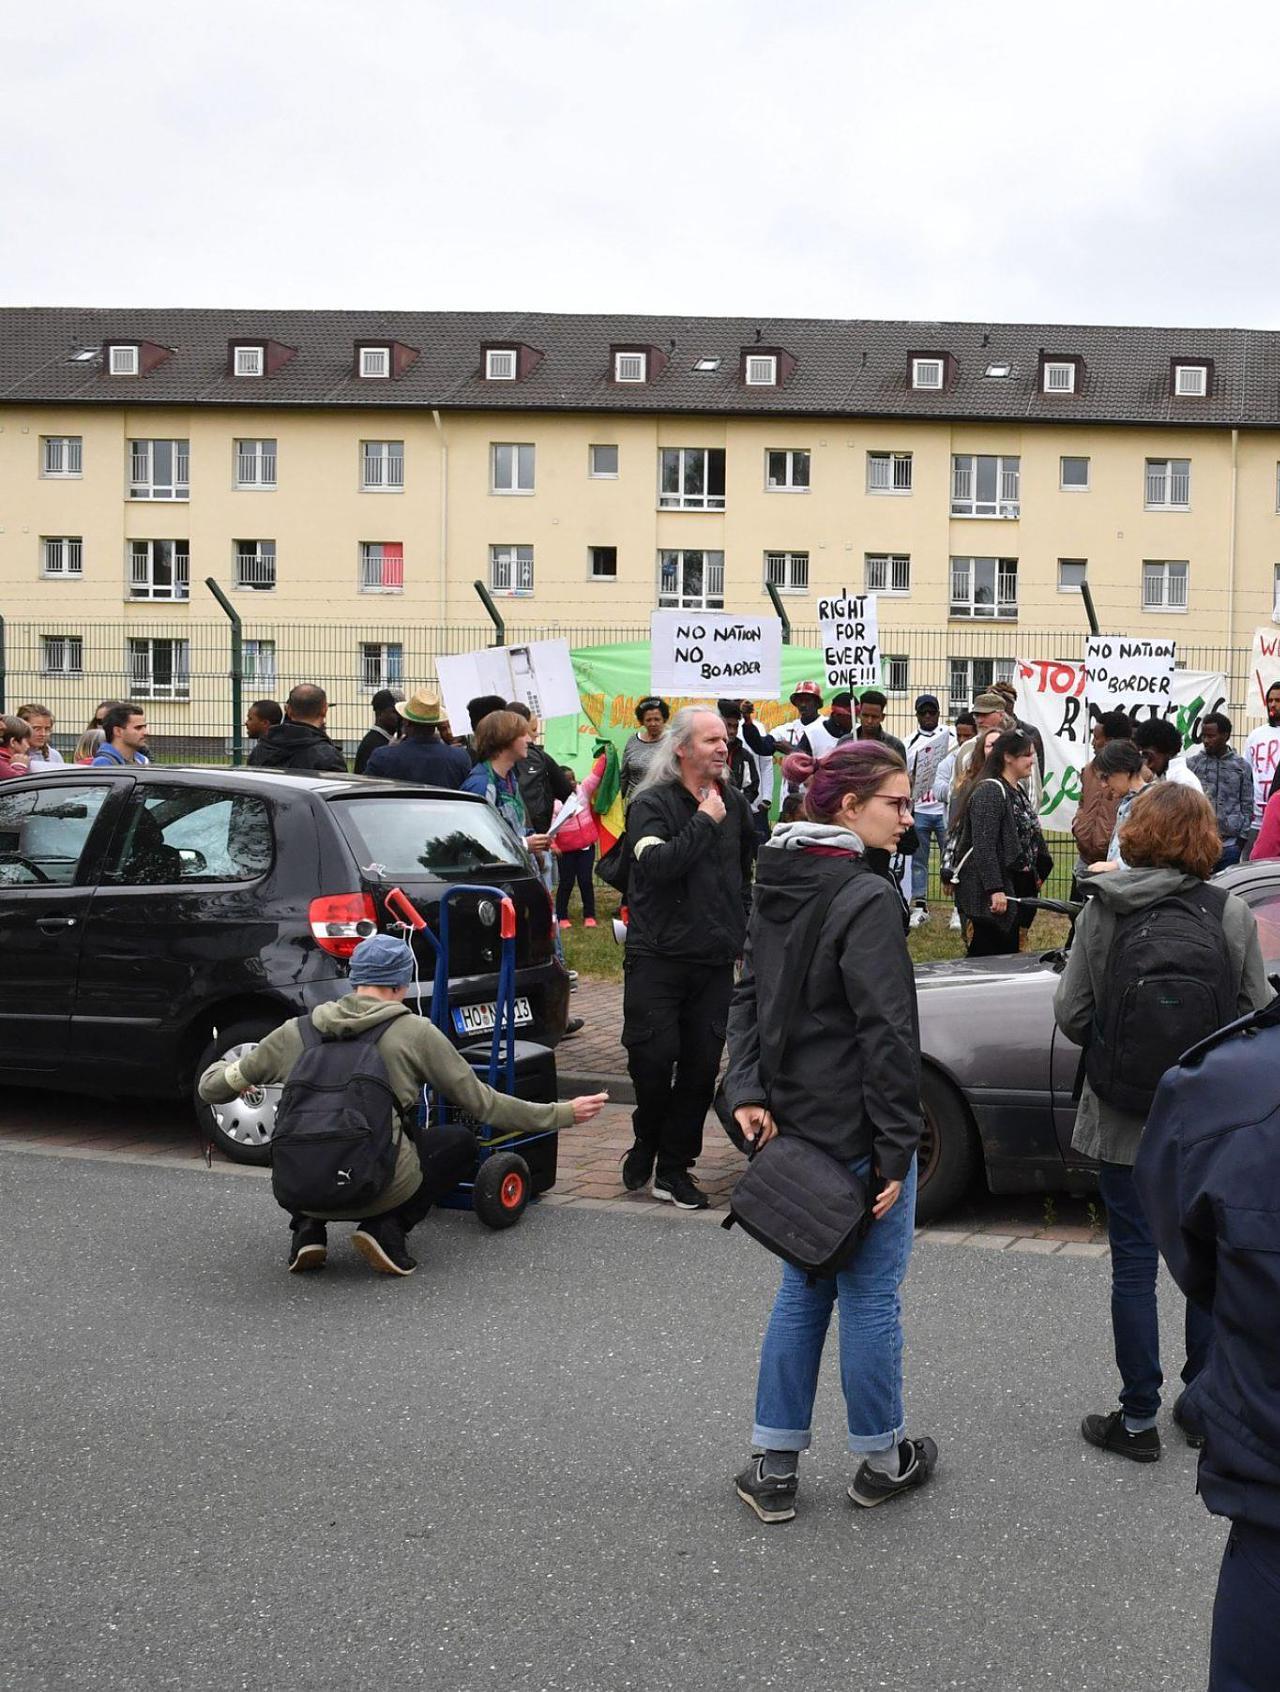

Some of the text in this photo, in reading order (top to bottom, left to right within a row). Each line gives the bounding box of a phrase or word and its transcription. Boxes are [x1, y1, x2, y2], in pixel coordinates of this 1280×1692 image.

[819, 595, 868, 620] RIGHT
[677, 625, 761, 642] NO NATION
[836, 622, 865, 641] FOR
[825, 645, 876, 666] EVERY
[1088, 641, 1176, 660] NO NATION
[675, 646, 761, 679] NO BOARDER
[828, 667, 876, 686] ONE!!!
[1086, 667, 1170, 695] NO BORDER
